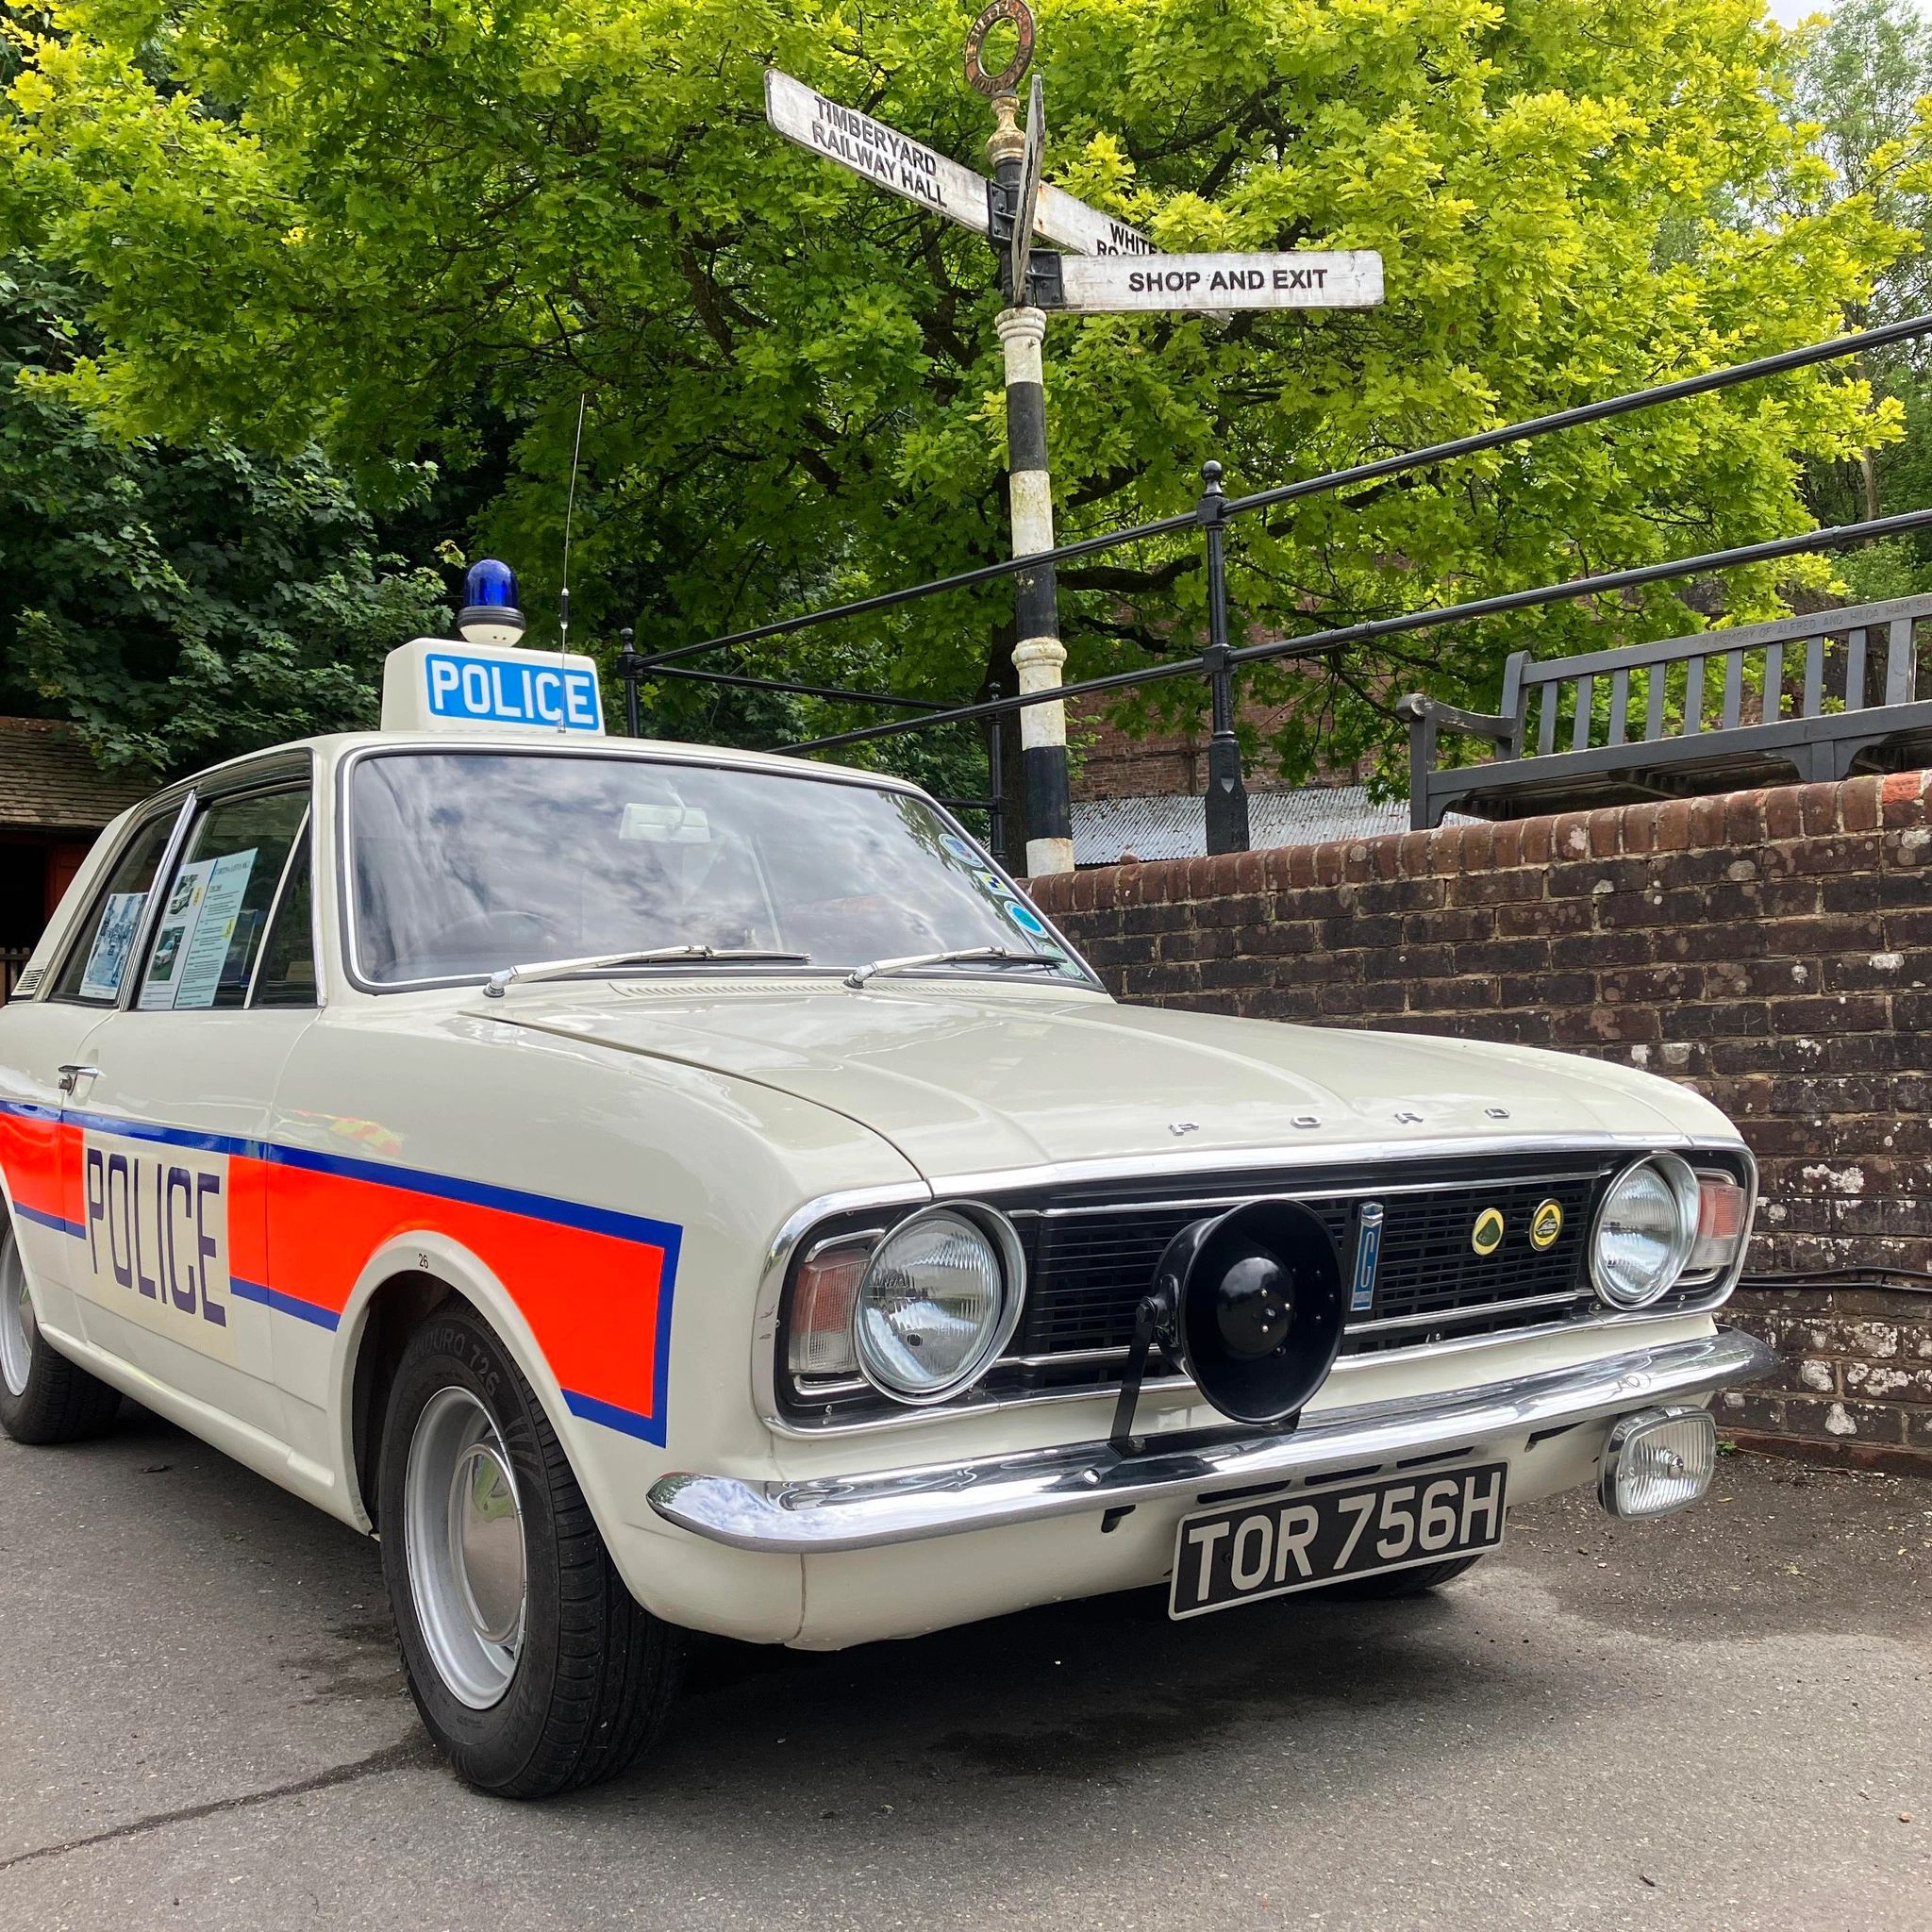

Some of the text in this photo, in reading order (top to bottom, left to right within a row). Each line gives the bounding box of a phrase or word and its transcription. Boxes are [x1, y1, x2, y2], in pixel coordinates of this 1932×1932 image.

[812, 120, 947, 208] RAILWAY HALL
[814, 95, 936, 176] TIMBERYARD
[1128, 269, 1328, 291] SHOP AND EXIT
[1714, 630, 1754, 644] MEMORY
[1758, 626, 1771, 638] OF
[1778, 619, 1816, 634] ALFRED
[1824, 614, 1842, 626] AND
[431, 659, 594, 724] POLICE
[87, 1147, 226, 1328] POLICE
[418, 1252, 429, 1269] 26
[1189, 1472, 1502, 1602] TOR 756H
